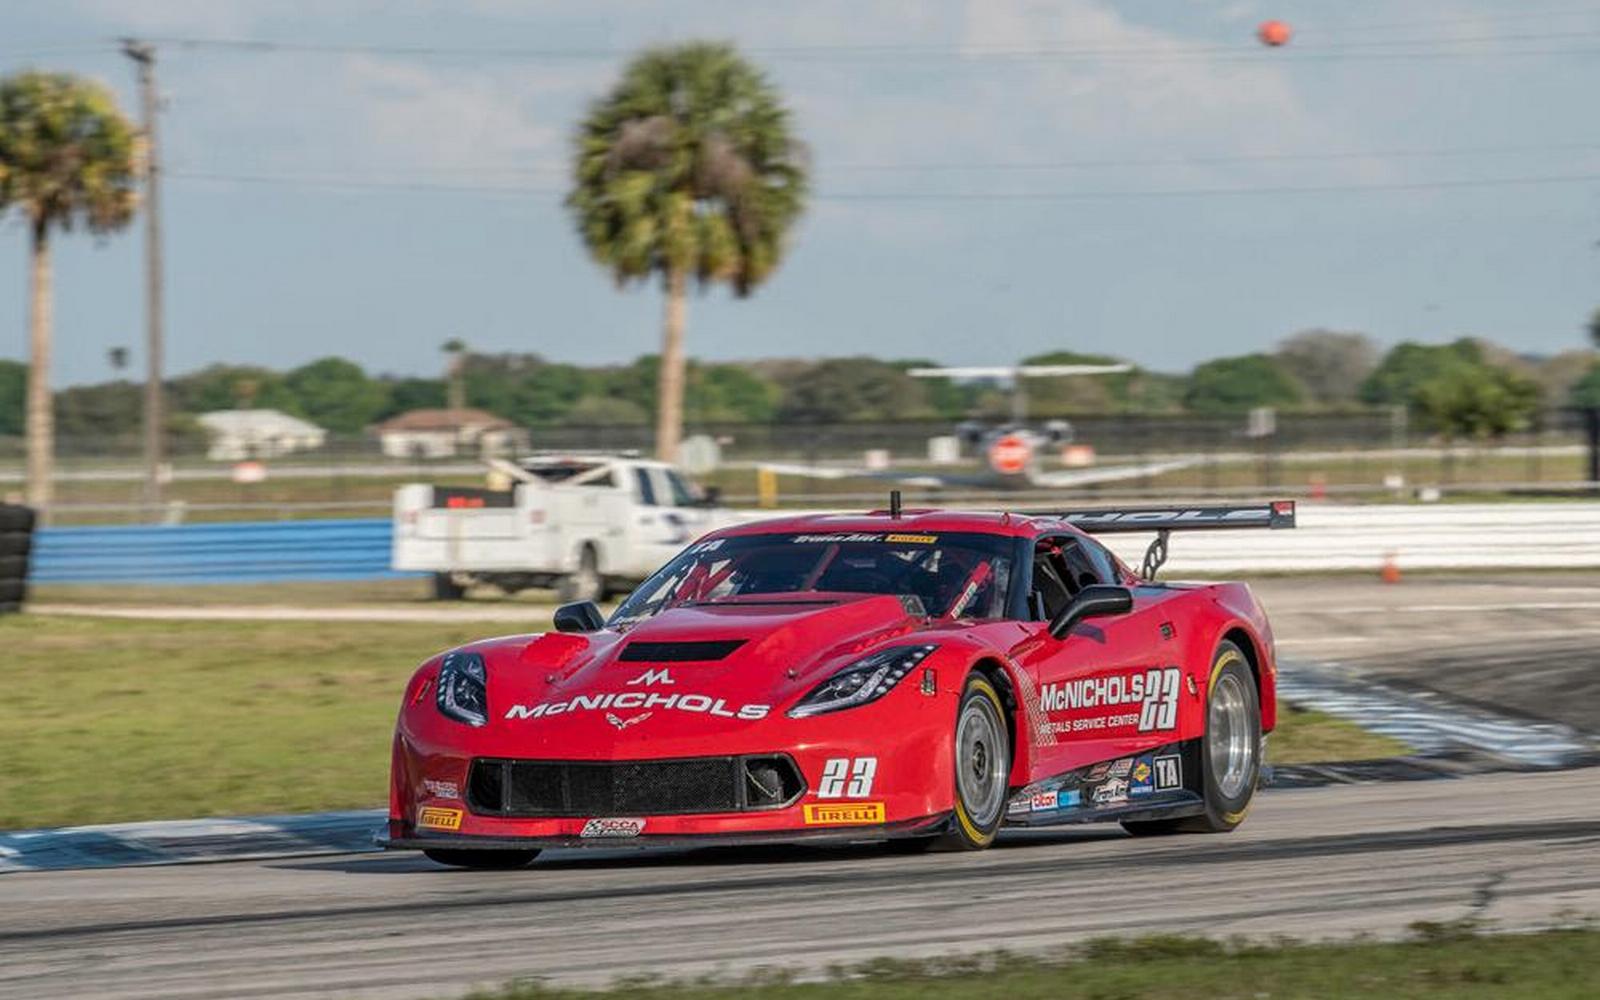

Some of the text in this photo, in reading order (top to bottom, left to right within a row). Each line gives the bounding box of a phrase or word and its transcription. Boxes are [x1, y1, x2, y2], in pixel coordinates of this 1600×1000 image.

[504, 692, 771, 720] McNICHOLS
[1040, 674, 1144, 712] McNICHOLS
[1138, 667, 1181, 732] 23
[1040, 714, 1140, 735] METALS SERVICE CENTER
[817, 757, 877, 798] 23
[1156, 759, 1179, 788] TA
[811, 804, 878, 821] PIRELLI
